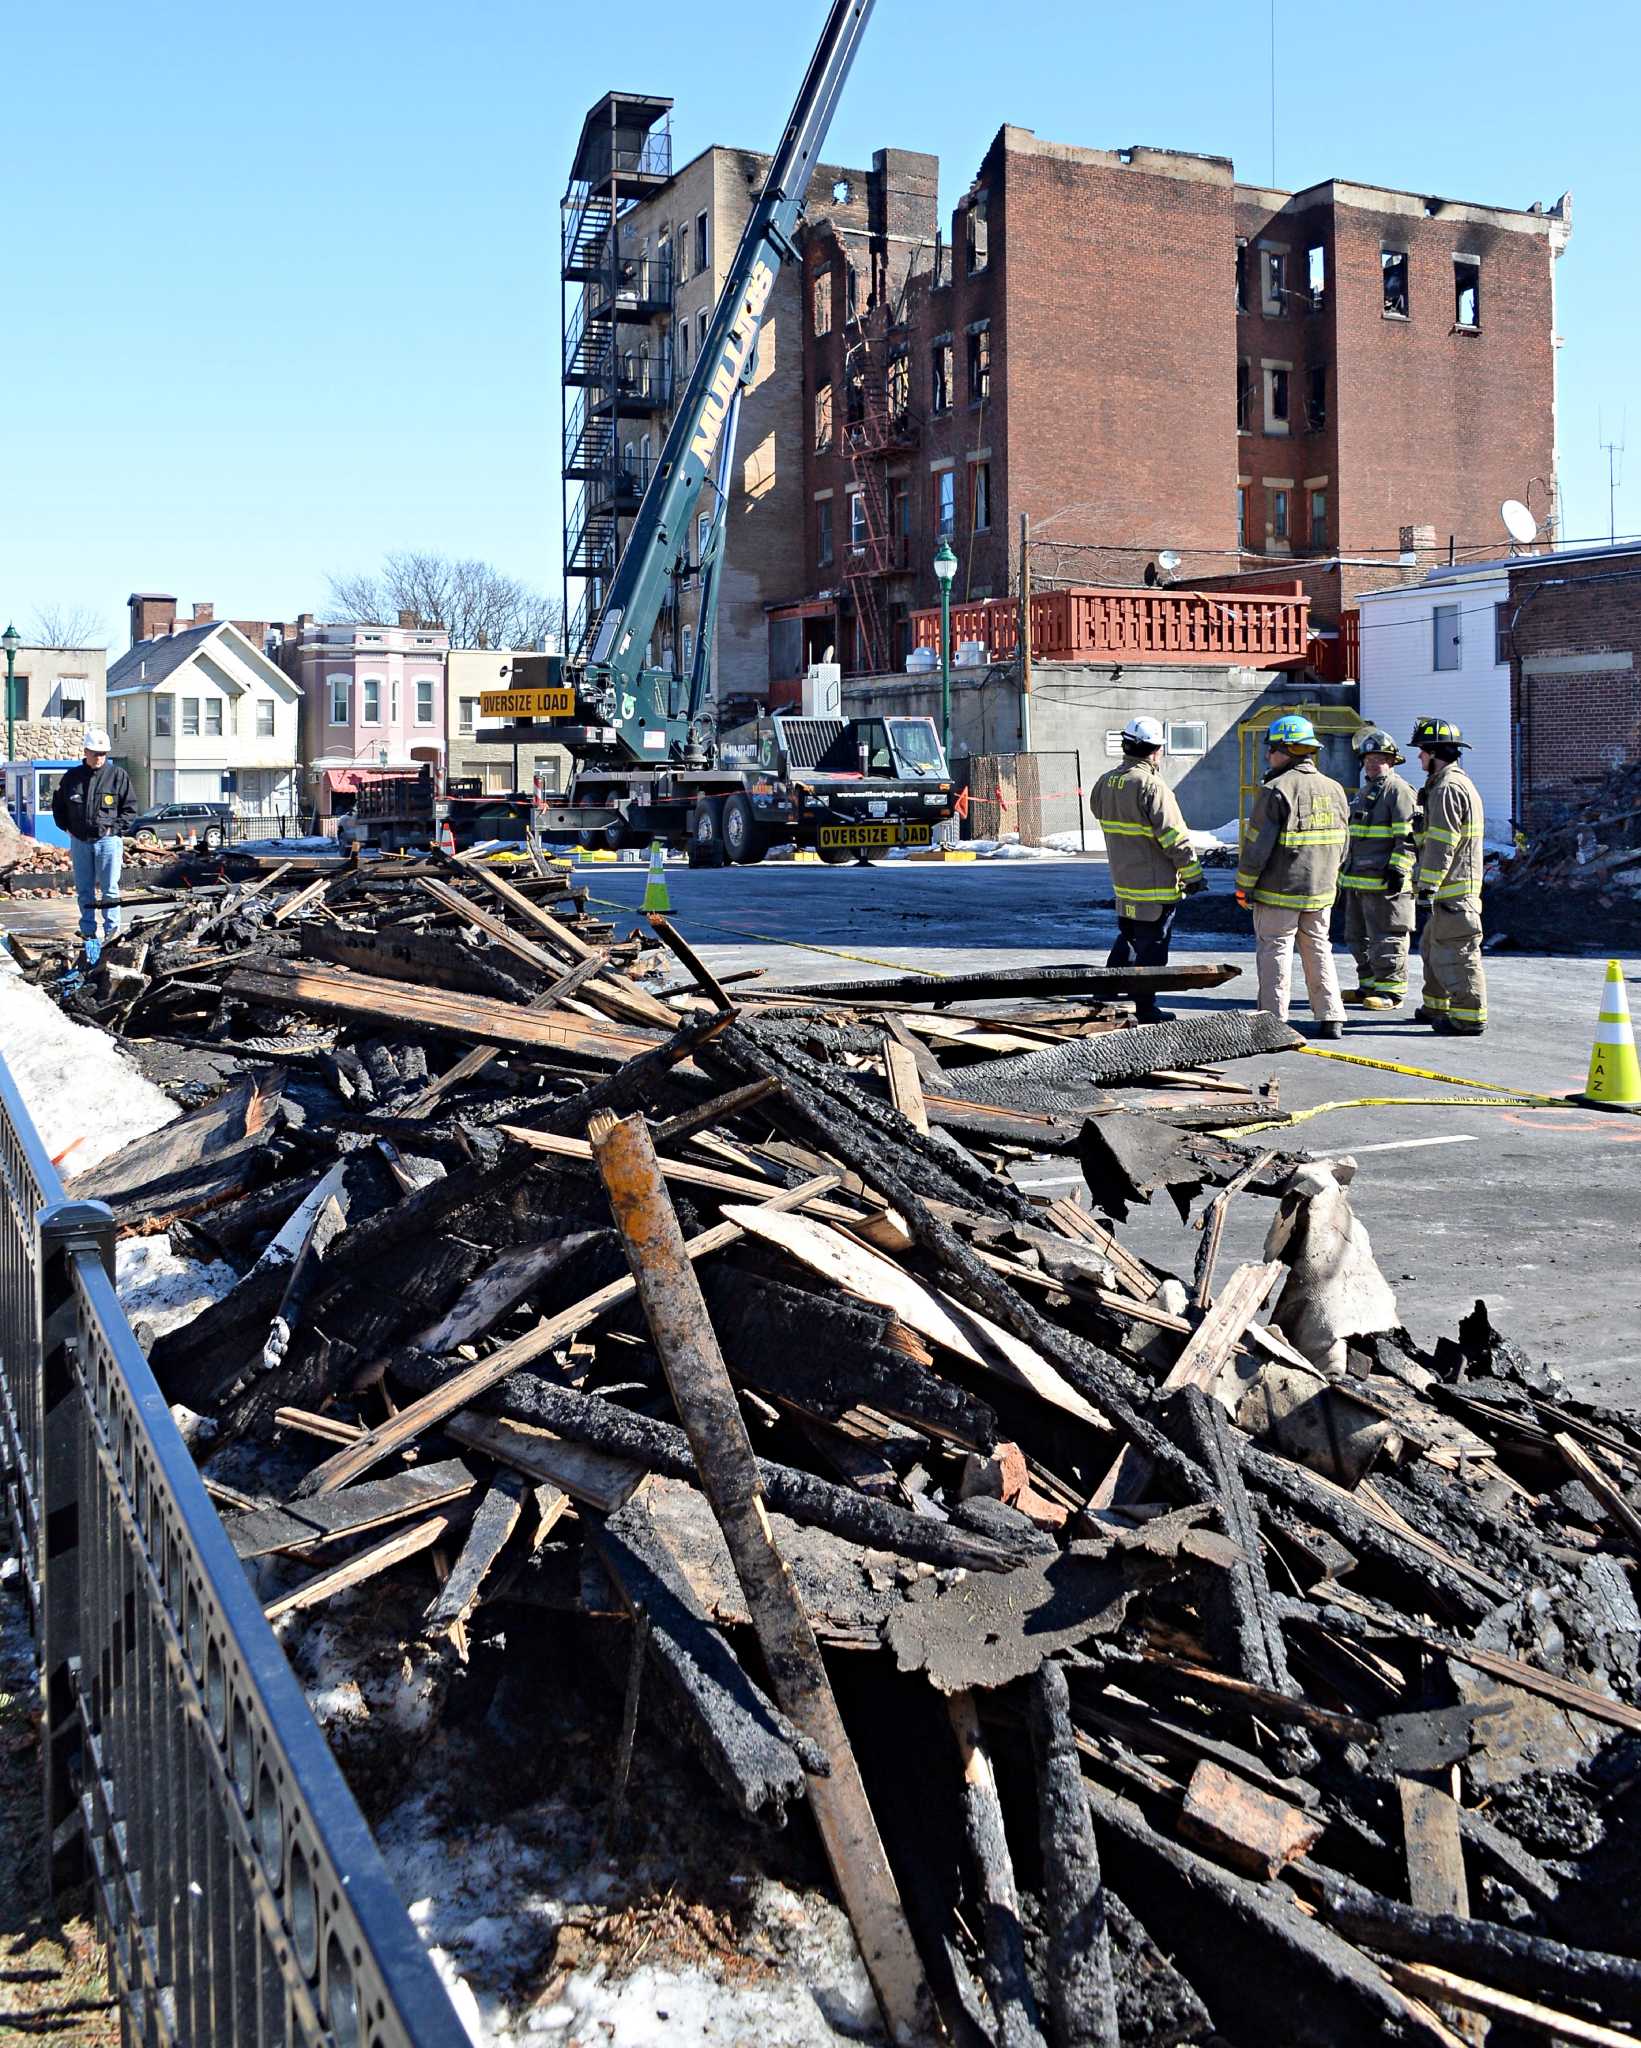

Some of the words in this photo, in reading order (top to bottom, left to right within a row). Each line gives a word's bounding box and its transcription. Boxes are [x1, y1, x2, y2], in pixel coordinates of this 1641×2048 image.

[690, 259, 774, 469] MULLINS
[483, 694, 532, 712] OVERSIZE
[537, 693, 569, 711] LOAD
[822, 828, 888, 845] OVERSIZE
[1593, 1047, 1606, 1092] LAZ
